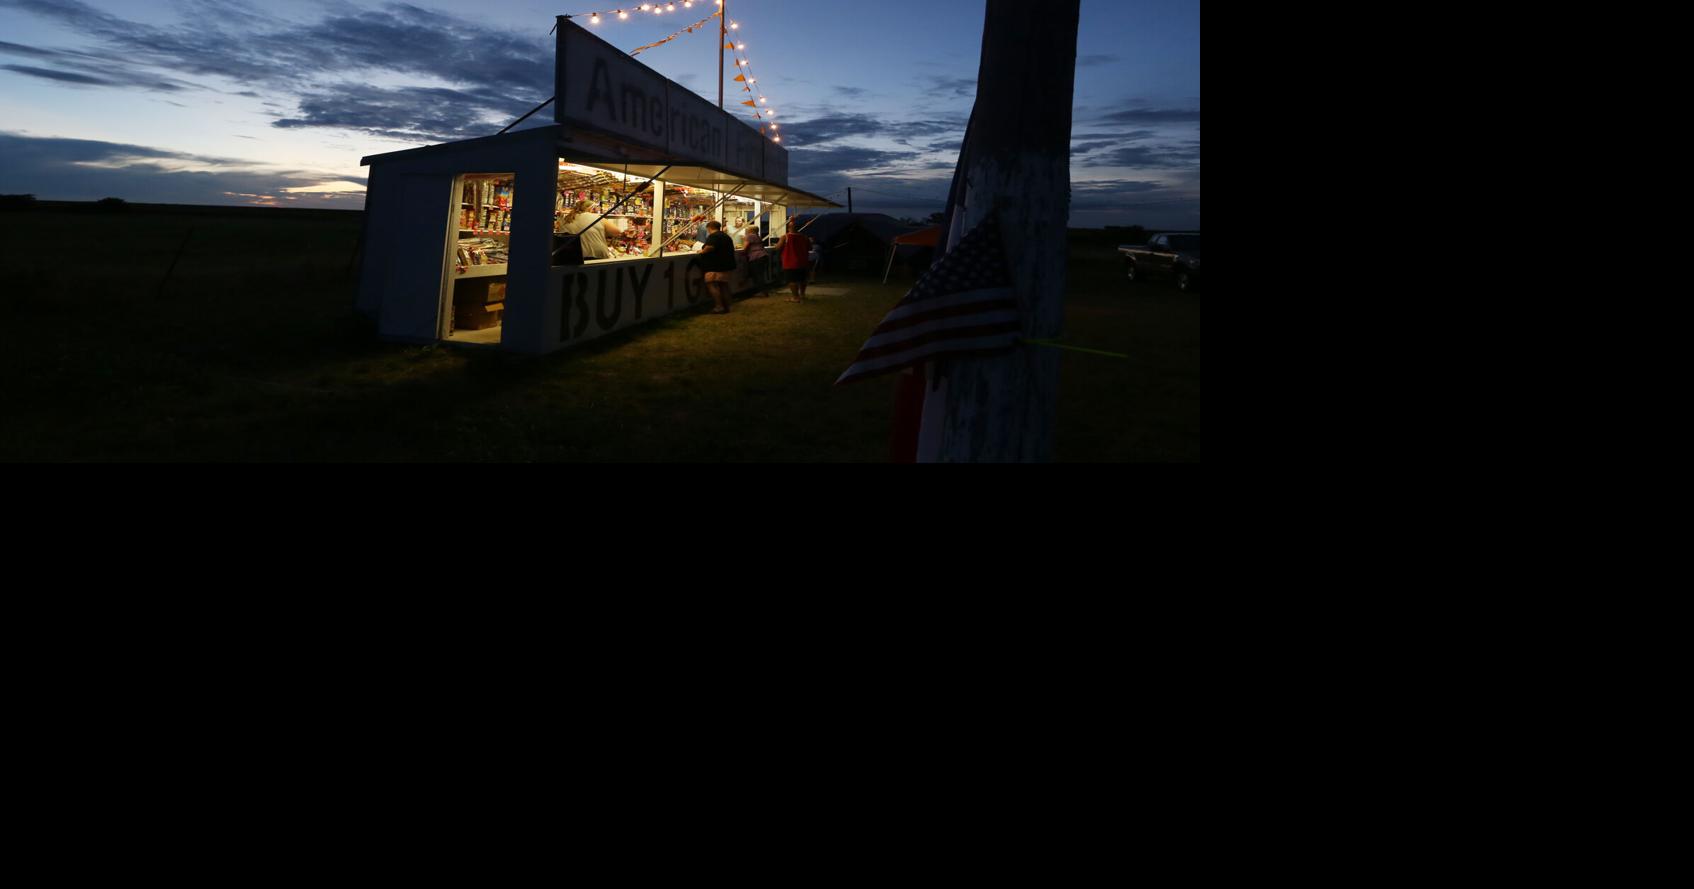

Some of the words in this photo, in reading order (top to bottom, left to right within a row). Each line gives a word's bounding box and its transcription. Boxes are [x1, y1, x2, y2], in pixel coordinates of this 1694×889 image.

[586, 57, 721, 157] American
[560, 263, 653, 342] BUY
[664, 260, 674, 310] 1
